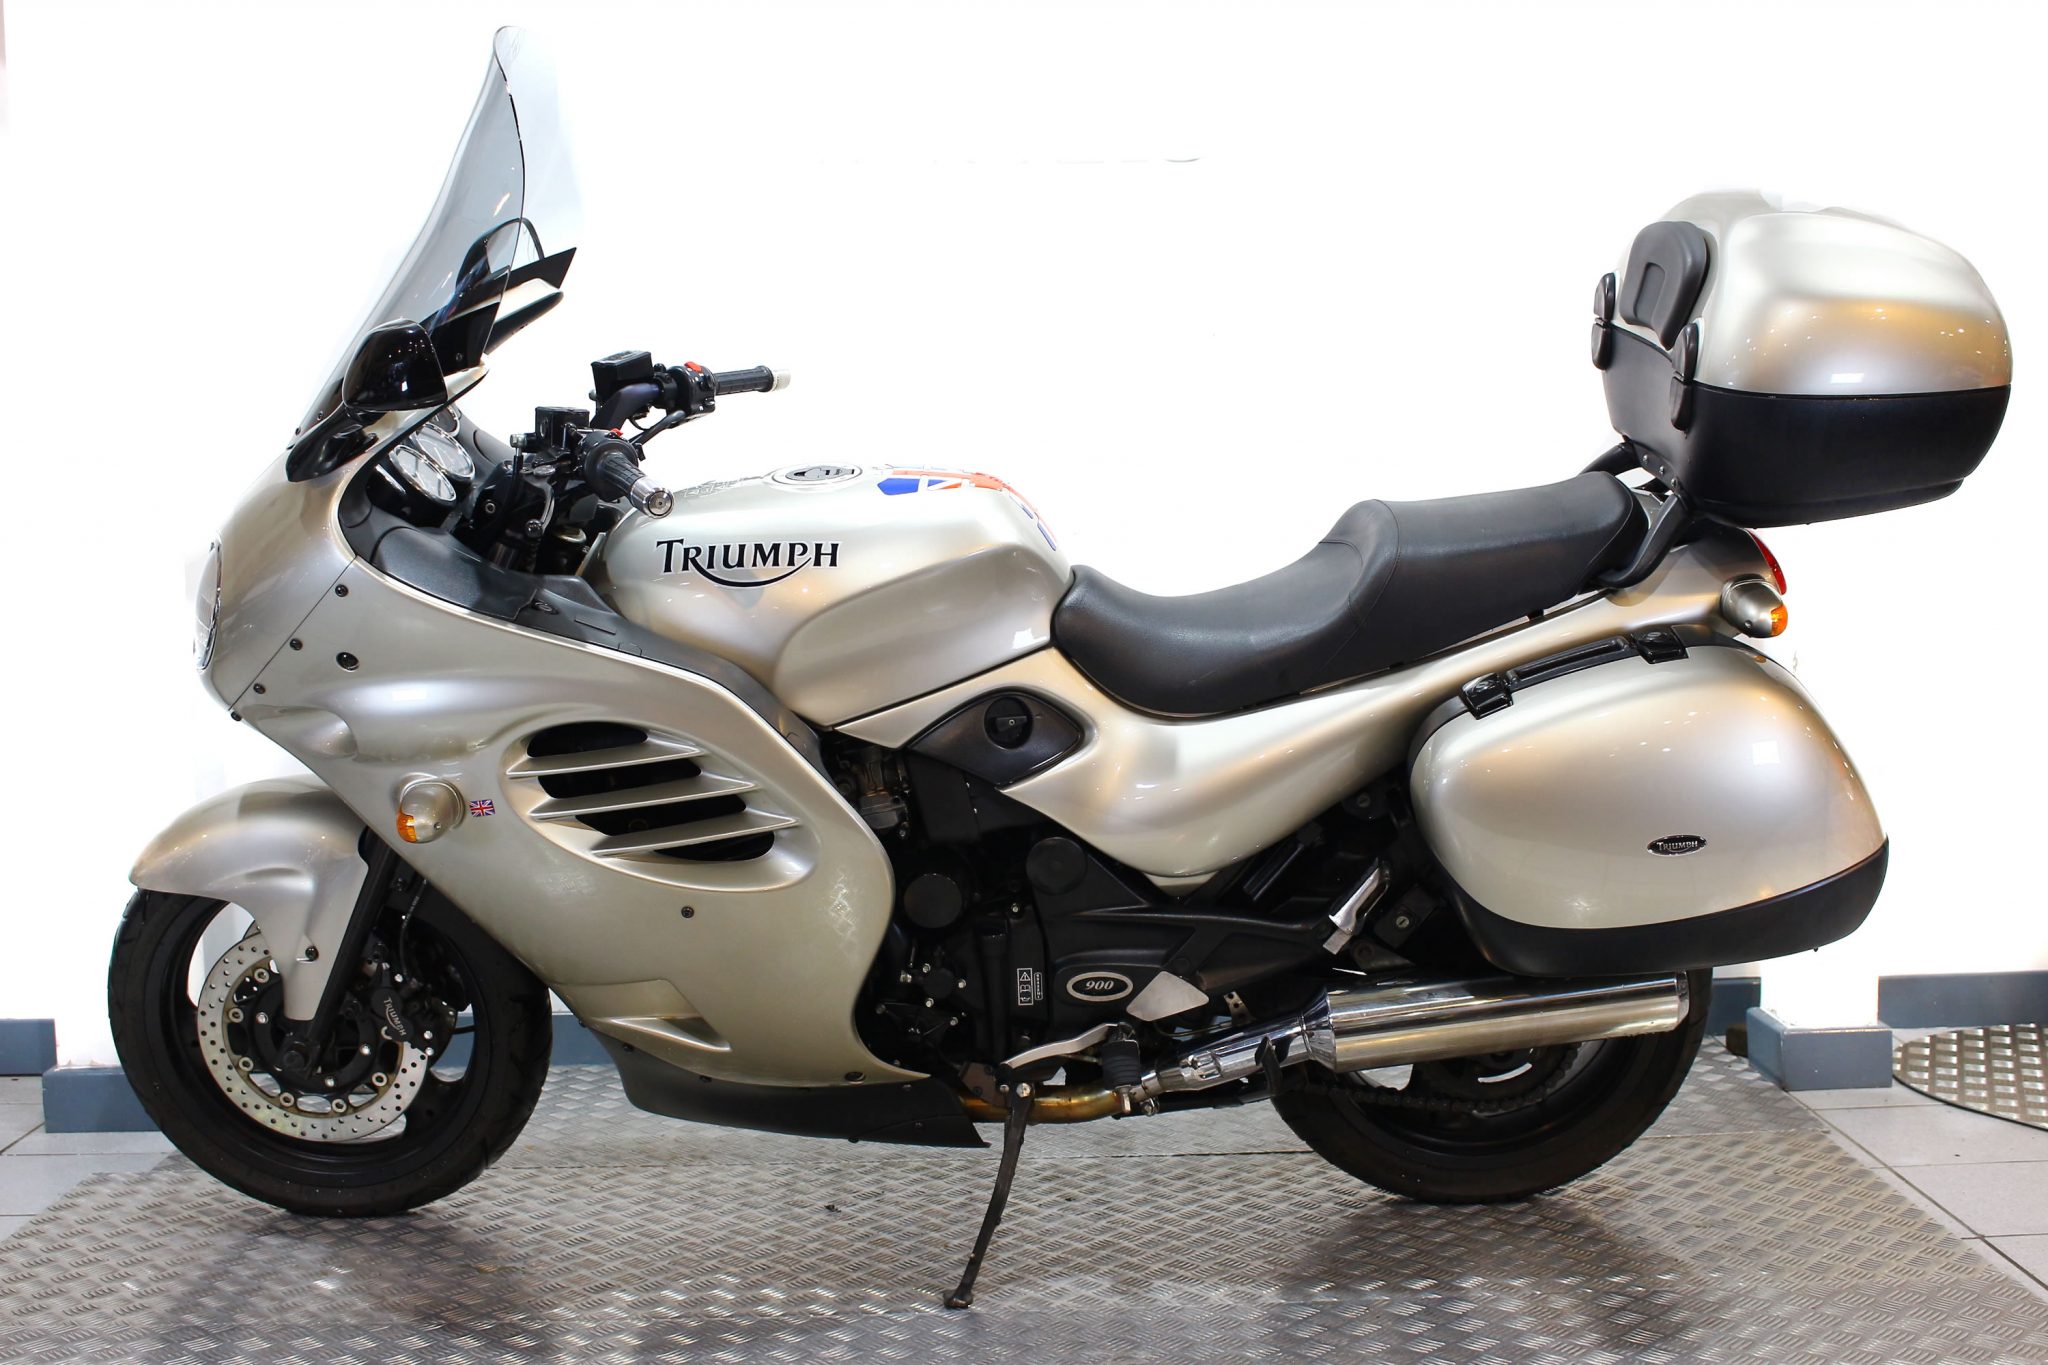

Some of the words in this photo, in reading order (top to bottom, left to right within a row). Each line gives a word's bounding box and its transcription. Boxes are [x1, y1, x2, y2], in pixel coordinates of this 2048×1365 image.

[656, 538, 840, 588] TRIUMPH
[1656, 840, 1698, 852] TRIUMPH
[1085, 980, 1115, 990] 900
[383, 996, 407, 1036] TRIUMPH
